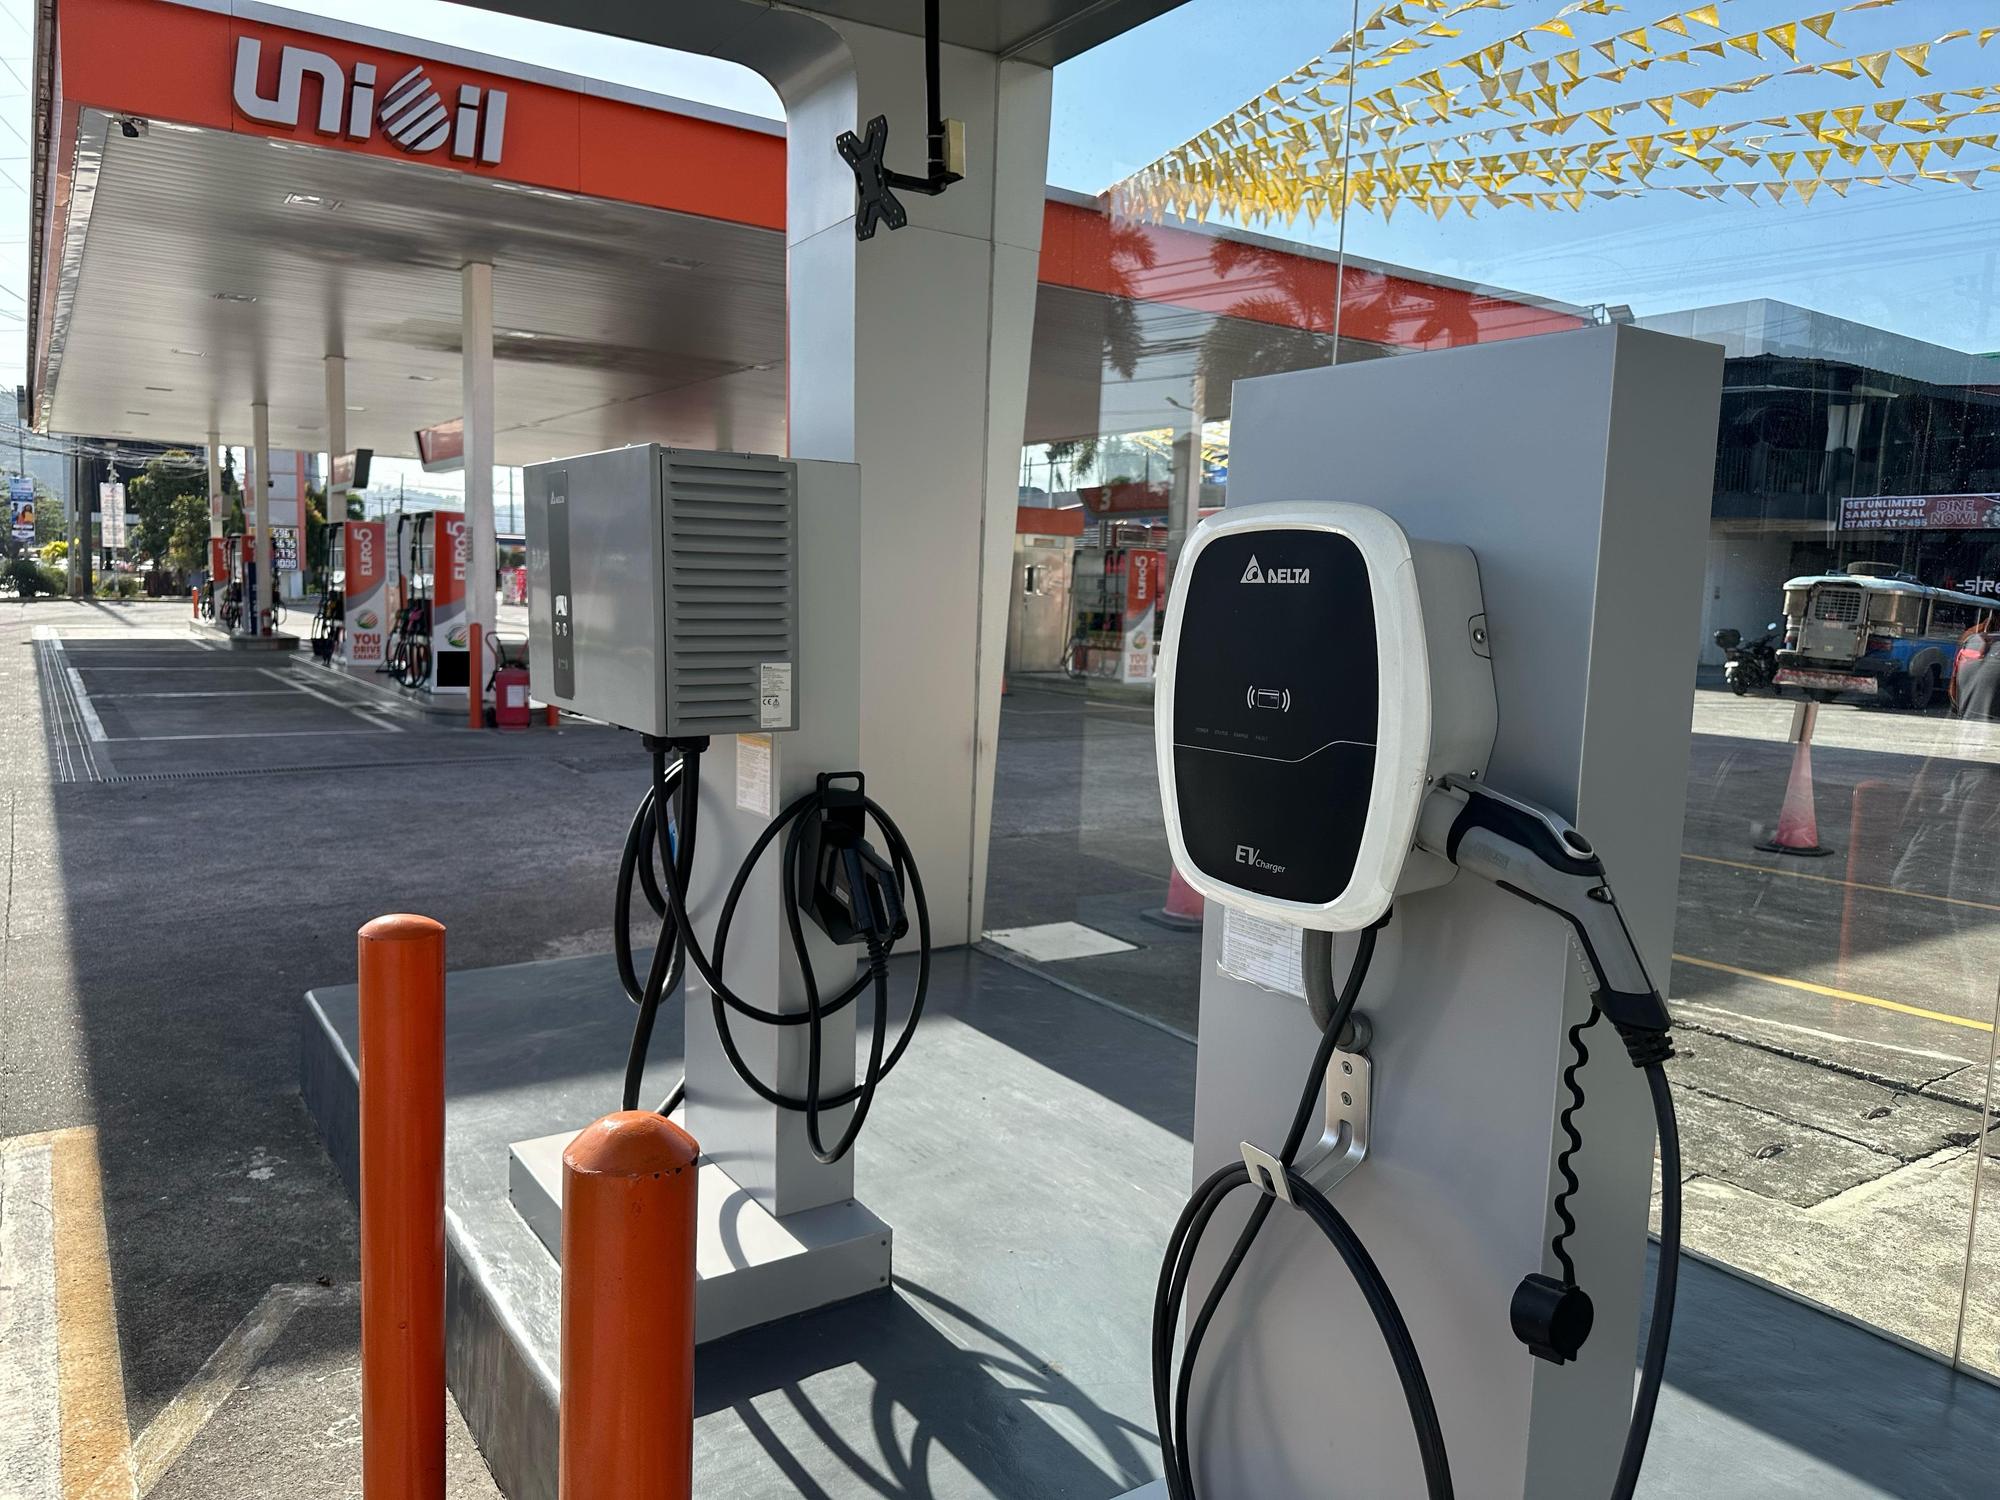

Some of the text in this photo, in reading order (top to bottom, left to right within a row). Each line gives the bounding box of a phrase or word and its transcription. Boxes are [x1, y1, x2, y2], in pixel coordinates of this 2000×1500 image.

[1846, 498, 1926, 509] GET UNLIMITED
[1936, 499, 1975, 512] DINE
[1845, 508, 1925, 519] SAMGYUPSAL
[1930, 511, 1978, 525] NOW!
[1844, 519, 1882, 529] STARTS
[1882, 519, 1898, 527] AT
[353, 528, 373, 577] EURO5
[1267, 568, 1310, 584] DELTA
[353, 633, 382, 645] YOU
[1235, 844, 1286, 874] EV Charger
